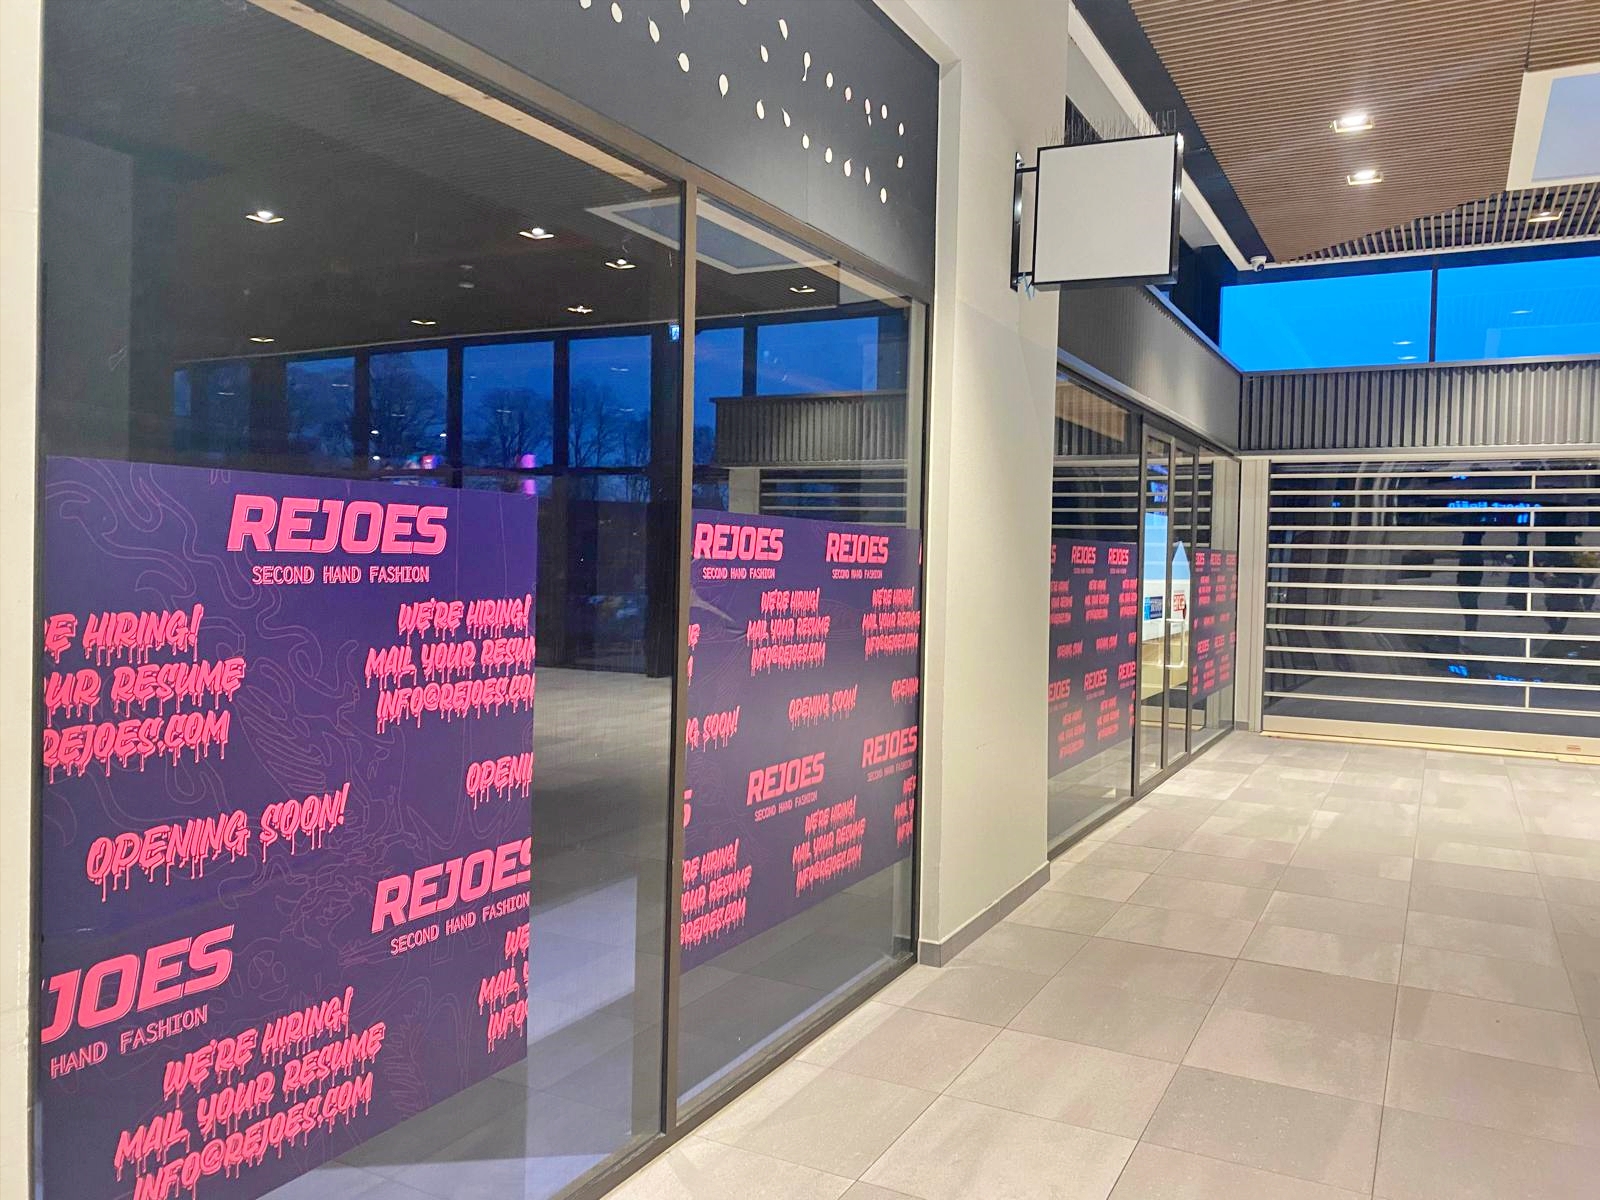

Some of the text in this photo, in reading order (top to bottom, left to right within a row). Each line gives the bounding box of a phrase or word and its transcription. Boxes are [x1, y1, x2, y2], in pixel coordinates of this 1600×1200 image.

[227, 494, 448, 554] REJOES
[693, 523, 784, 561] REJOES
[826, 533, 889, 564] REJOES
[252, 566, 430, 584] SECOND HAND FASHION
[703, 567, 727, 579] SECOND
[750, 567, 775, 579] FASHION
[398, 594, 532, 645] WE'RE HIRING!
[761, 588, 790, 619] WE'RE
[83, 604, 204, 666] HIRING!
[746, 616, 830, 648] MAIL YOUR RESUME
[365, 646, 417, 690] MAIL
[421, 640, 476, 683] YOUR
[44, 658, 246, 726] UR RESUME
[788, 685, 858, 729] OPENING SOON!
[703, 705, 740, 751] SOON!
[862, 726, 918, 768] REJOES
[466, 752, 533, 809] OPENI
[746, 752, 825, 806] REJOES
[86, 783, 350, 901] OPENING SOON!
[701, 838, 739, 882] HIRING!
[709, 865, 752, 908] RESUME
[390, 891, 530, 955] SECOND HAND FASHION
[41, 924, 234, 1044] JOES
[478, 967, 519, 1015] MAIL
[51, 1005, 208, 1079] HAND FASHION
[163, 986, 353, 1107] WE'RE HIRING!
[114, 1022, 385, 1181] MAIL YOUR RESUME
[133, 1072, 373, 1200] INFO@REJOES.COM
